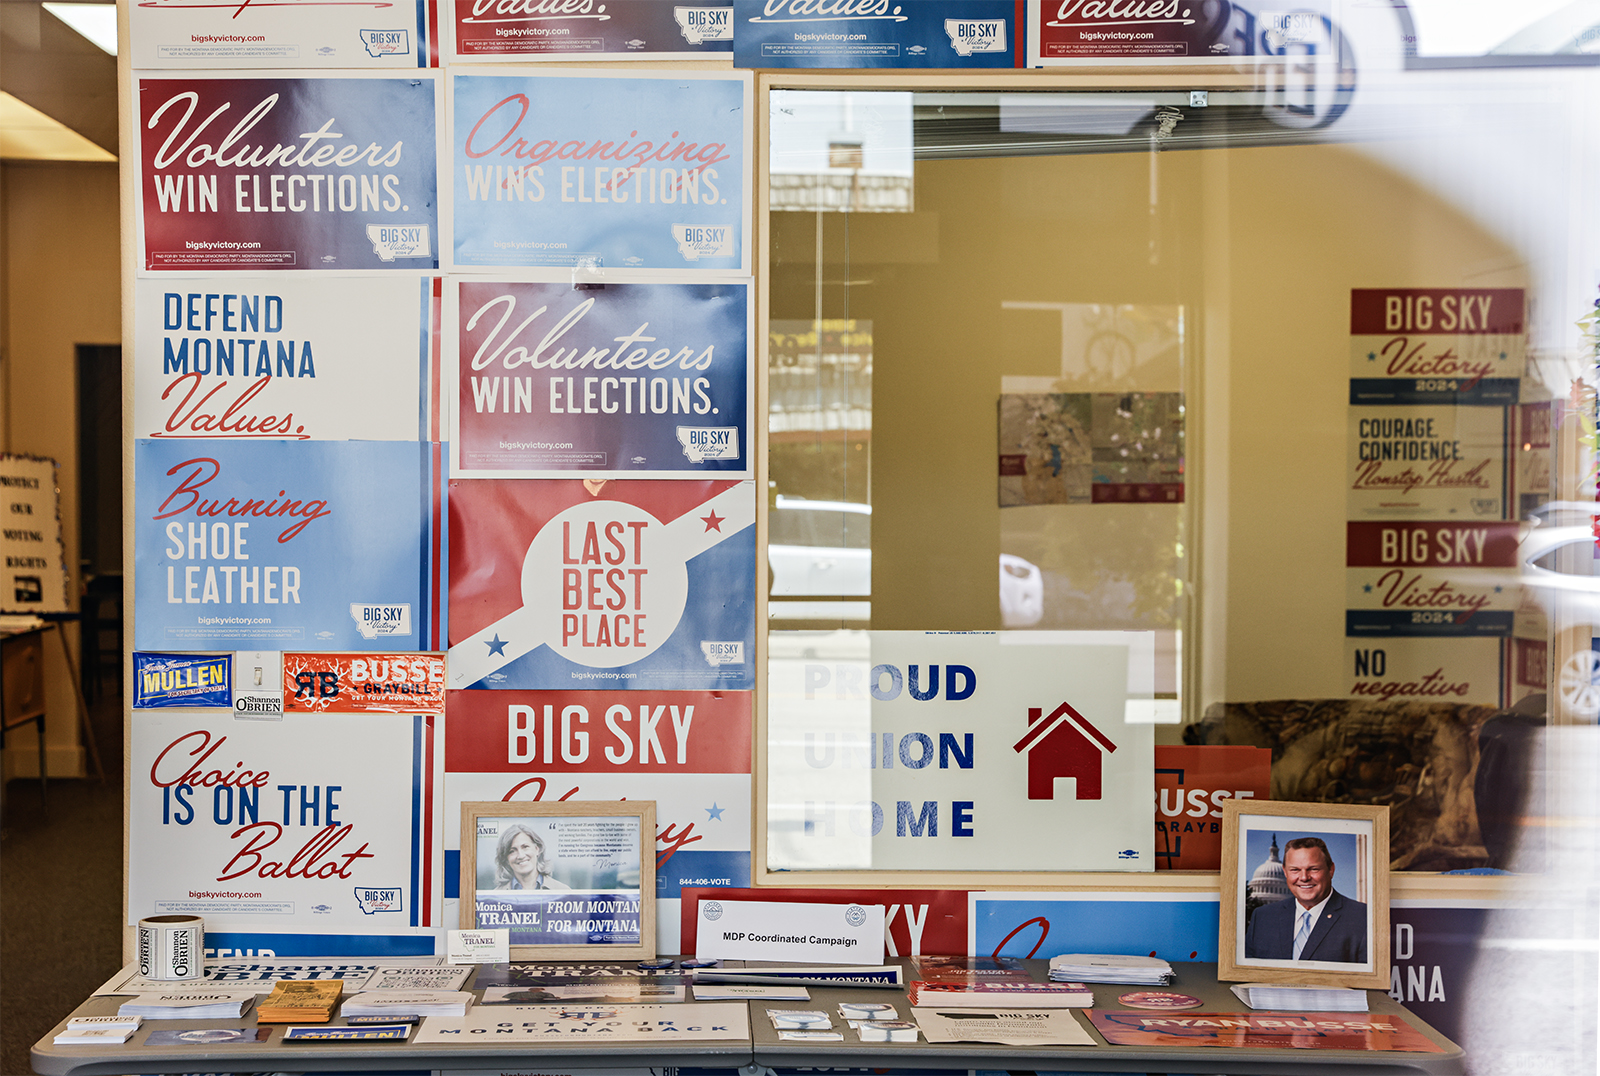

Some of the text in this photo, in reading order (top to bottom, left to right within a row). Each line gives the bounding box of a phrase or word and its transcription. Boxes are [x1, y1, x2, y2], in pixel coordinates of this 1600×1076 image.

[472, 0, 606, 16] aues.
[762, 0, 902, 15] aues.
[688, 10, 728, 26] BIG SKY
[1273, 14, 1314, 29] BIG SKY
[496, 28, 570, 37] bigskyvictory.com
[695, 23, 724, 37] Victory
[794, 33, 867, 41] bigskyvictory.com
[957, 23, 998, 37] BIG SKY
[1080, 32, 1154, 41] bigskyvictory.com
[191, 34, 266, 43] bigskyvictory.com
[370, 33, 401, 44] BIG SKY
[965, 35, 994, 48] Victory
[376, 42, 398, 52] Victory
[147, 91, 403, 170] Volunteers
[464, 93, 730, 191] Organizing
[464, 164, 727, 205] WINS ELECTIONS.
[154, 174, 409, 213] WIN ELECTIONS.
[380, 228, 421, 243] BIG SKY
[684, 228, 725, 243] BIG SKY
[186, 241, 261, 251] bigskyvictory.com
[387, 241, 416, 255] Victory
[493, 240, 568, 250] bigskyvictory.com
[692, 241, 721, 254] Victory
[163, 292, 283, 333] DEFEND
[1385, 295, 1492, 331] BIG SKY
[466, 294, 715, 371] Volunteers
[163, 337, 316, 378] MONTANA
[1381, 336, 1495, 393] Victory
[1415, 381, 1458, 391] 2024
[161, 371, 304, 434] Values.
[471, 376, 719, 414] WIN ELECTIONS.
[1359, 418, 1439, 438] COURAGE.
[690, 430, 730, 445] BIG SKY
[500, 441, 573, 450] bigskyvictory.com
[697, 443, 725, 457] Victory
[1359, 441, 1465, 461] CONFIDENCE.
[1353, 457, 1423, 494] Nonstop
[152, 457, 331, 544] Burning
[10, 502, 33, 515] OUR
[3, 529, 43, 542] VOTING
[165, 522, 250, 560] SHOE
[562, 521, 648, 566] LAST
[1381, 528, 1487, 563] BIG SKY
[6, 556, 47, 569] RIGHTS
[167, 566, 301, 604] LEATHER
[562, 568, 648, 611] BEST
[1376, 569, 1491, 625] Victory
[198, 616, 271, 626] bigskyvictory.com
[363, 607, 403, 622] BIG SKY
[1411, 613, 1454, 624] 2024
[371, 620, 399, 632] Victory
[562, 614, 647, 648] PLACE
[709, 643, 739, 654] BIG SKY
[351, 659, 444, 682] BUSSE
[1354, 649, 1386, 677] NO
[143, 664, 223, 693] MULLEN
[571, 671, 637, 681] bigskyvictory.com
[804, 664, 977, 701] PROUD
[363, 683, 432, 695] GRAYBILL
[1351, 667, 1470, 702] negative
[246, 696, 281, 704] Shannon
[508, 704, 695, 765] BIG SKY
[804, 732, 975, 769] UNION
[150, 730, 270, 788] Choice
[163, 783, 342, 827] IS ON THE
[1155, 788, 1254, 818] USS
[804, 800, 975, 838] HOME
[477, 827, 498, 835] ANEL
[1157, 821, 1220, 833] GRAYB
[216, 821, 374, 882] Ballot
[679, 878, 731, 886] 844-406-VOTE
[188, 890, 262, 899] bigskyvictory.com
[364, 890, 395, 901] BIG SKY
[369, 900, 391, 910] Victory
[475, 902, 513, 912] Monica
[546, 901, 640, 914] FROM MONTAN
[479, 912, 540, 925] TRANEL
[546, 919, 637, 933] FOR MONTANA
[885, 904, 929, 956] KY
[723, 932, 858, 947] MDP Coordinated Campaign
[1140, 1018, 1398, 1031] RYAN BUSSE
